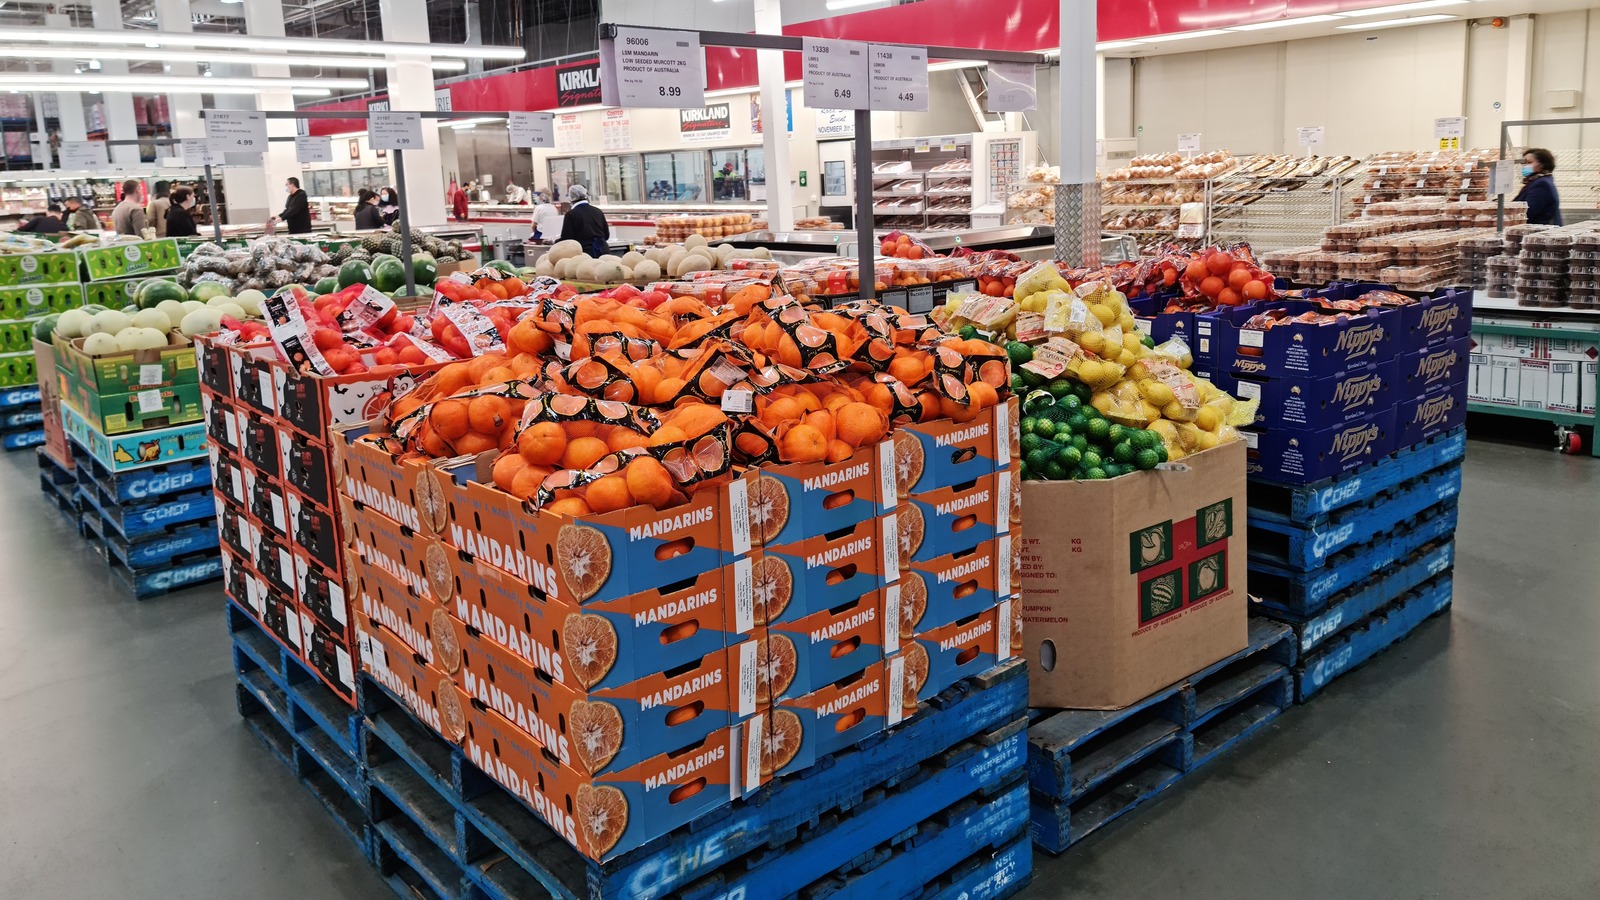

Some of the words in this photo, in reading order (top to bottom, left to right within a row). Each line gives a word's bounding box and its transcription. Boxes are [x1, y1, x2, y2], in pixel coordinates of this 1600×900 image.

[626, 37, 649, 46] 96006
[659, 86, 681, 96] 8.99
[834, 89, 851, 98] 6.49
[898, 93, 914, 101] 4.49
[681, 106, 728, 122] KIRKLAND
[1418, 302, 1459, 337] Nippy's
[1333, 322, 1384, 361] Nippy's
[1232, 359, 1267, 373] Nippy's
[1415, 350, 1457, 386] Nippy's
[1330, 373, 1382, 412] Nippy's
[1412, 394, 1454, 431] Nippy's
[935, 423, 989, 448] MANDARINS
[1328, 423, 1379, 462] Nippy's
[149, 472, 194, 494] CHEP
[803, 462, 870, 493] MANDARINS
[345, 475, 420, 533] MANDARINS
[936, 490, 989, 516] MANDARINS
[629, 505, 714, 542] MANDARINS
[1325, 522, 1354, 545] CHEP
[450, 522, 559, 599] MANDARINS
[806, 536, 872, 570] MANDARINS
[937, 555, 990, 584] MANDARINS
[173, 562, 219, 582] CHEP
[635, 588, 718, 628] MANDARINS
[1131, 626, 1151, 638] PRODUCE
[1160, 613, 1182, 626] AUSTRALIA
[1190, 601, 1208, 613] PRODUCE
[1215, 590, 1234, 602] AUSTRALIA
[1312, 612, 1342, 639] CHEP
[362, 592, 434, 665] MANDARINS
[456, 595, 565, 684] MANDARINS
[811, 607, 875, 645] MANDARINS
[940, 620, 992, 652] MANDARINS
[641, 668, 722, 712] MANDARINS
[816, 679, 880, 719] MANDARINS
[463, 667, 570, 766] MANDARINS
[645, 744, 725, 792] MANDARINS
[971, 746, 1018, 777] PROPERTY
[468, 738, 578, 847] MANDARINS
